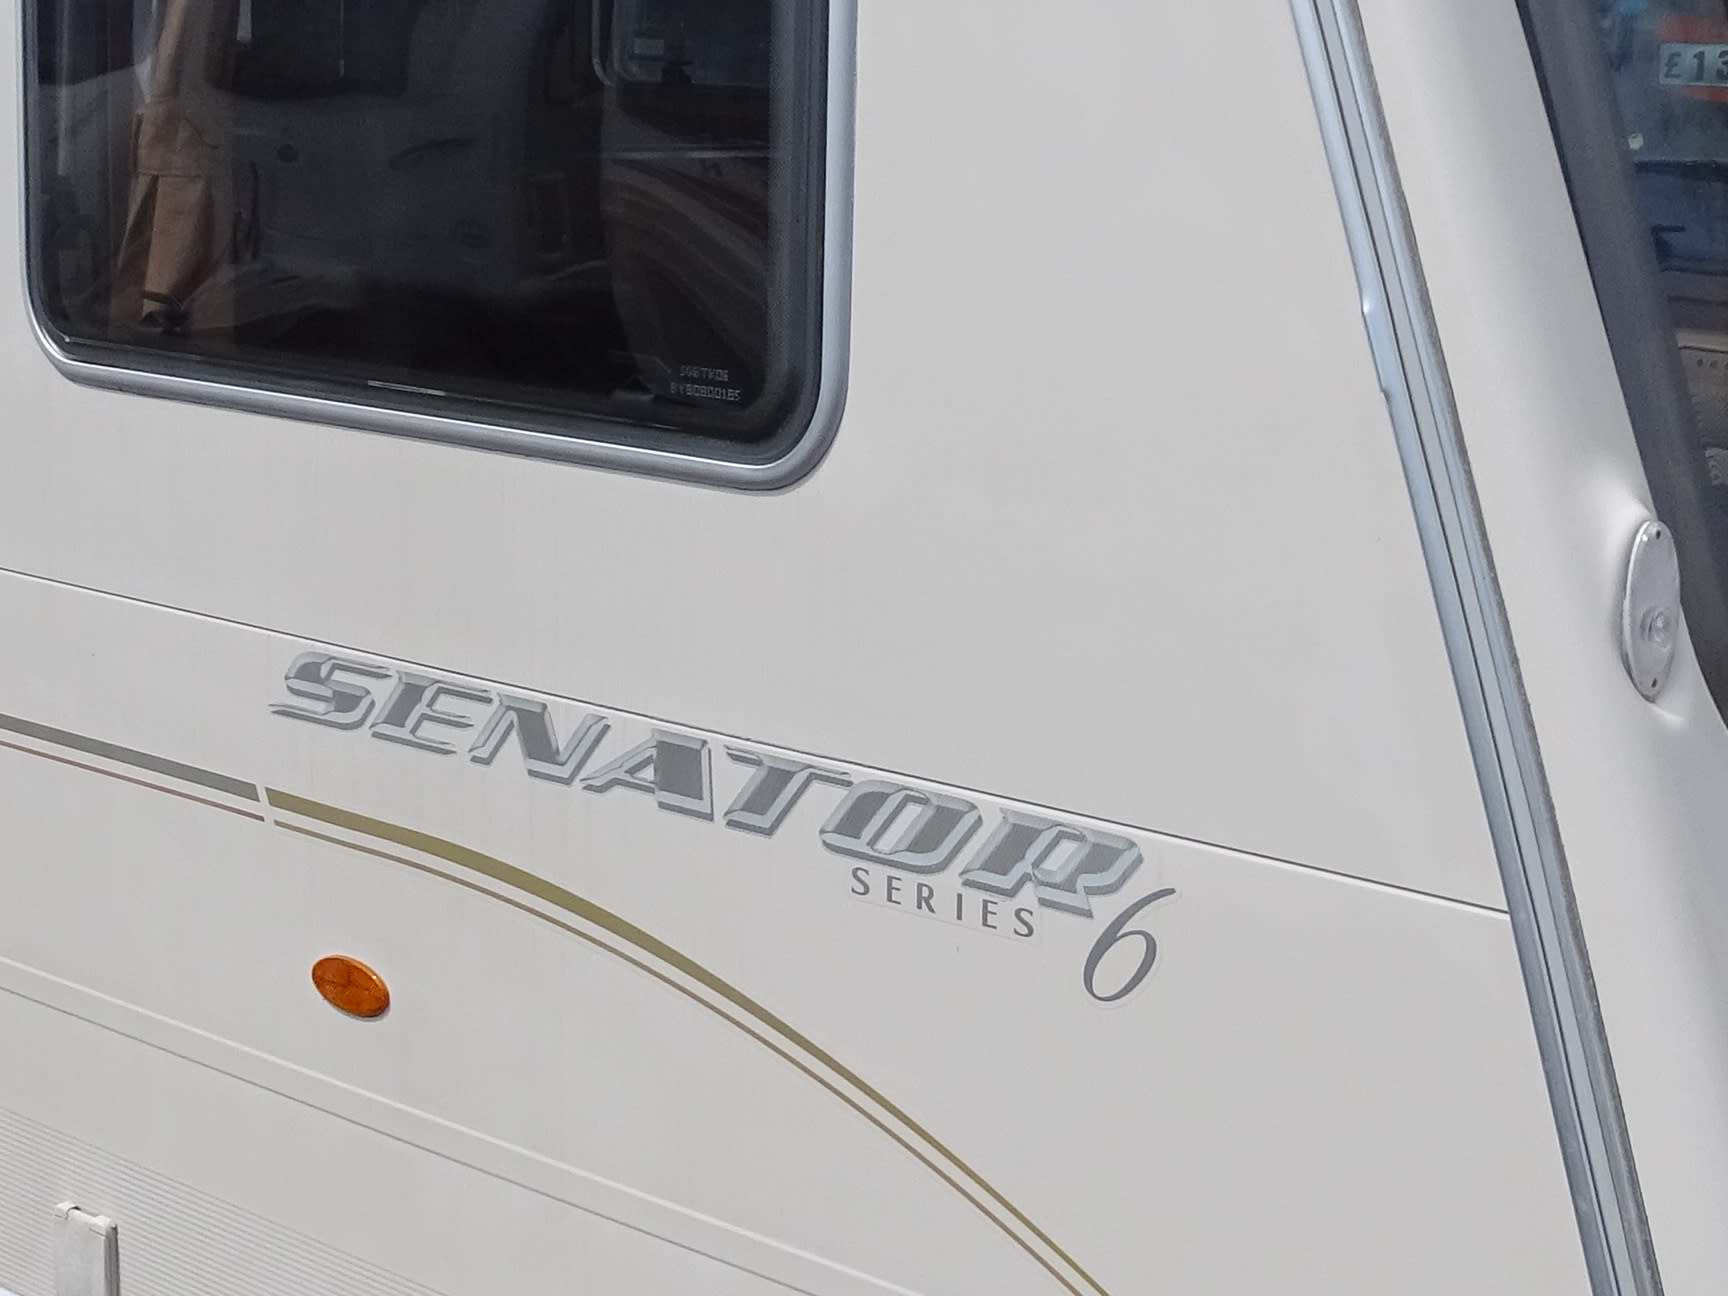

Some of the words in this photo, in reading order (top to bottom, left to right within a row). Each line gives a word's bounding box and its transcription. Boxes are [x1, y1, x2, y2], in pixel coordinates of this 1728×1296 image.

[268, 649, 1145, 920] SENATOR
[848, 865, 1038, 939] SERIES
[1081, 886, 1178, 1003] 6
